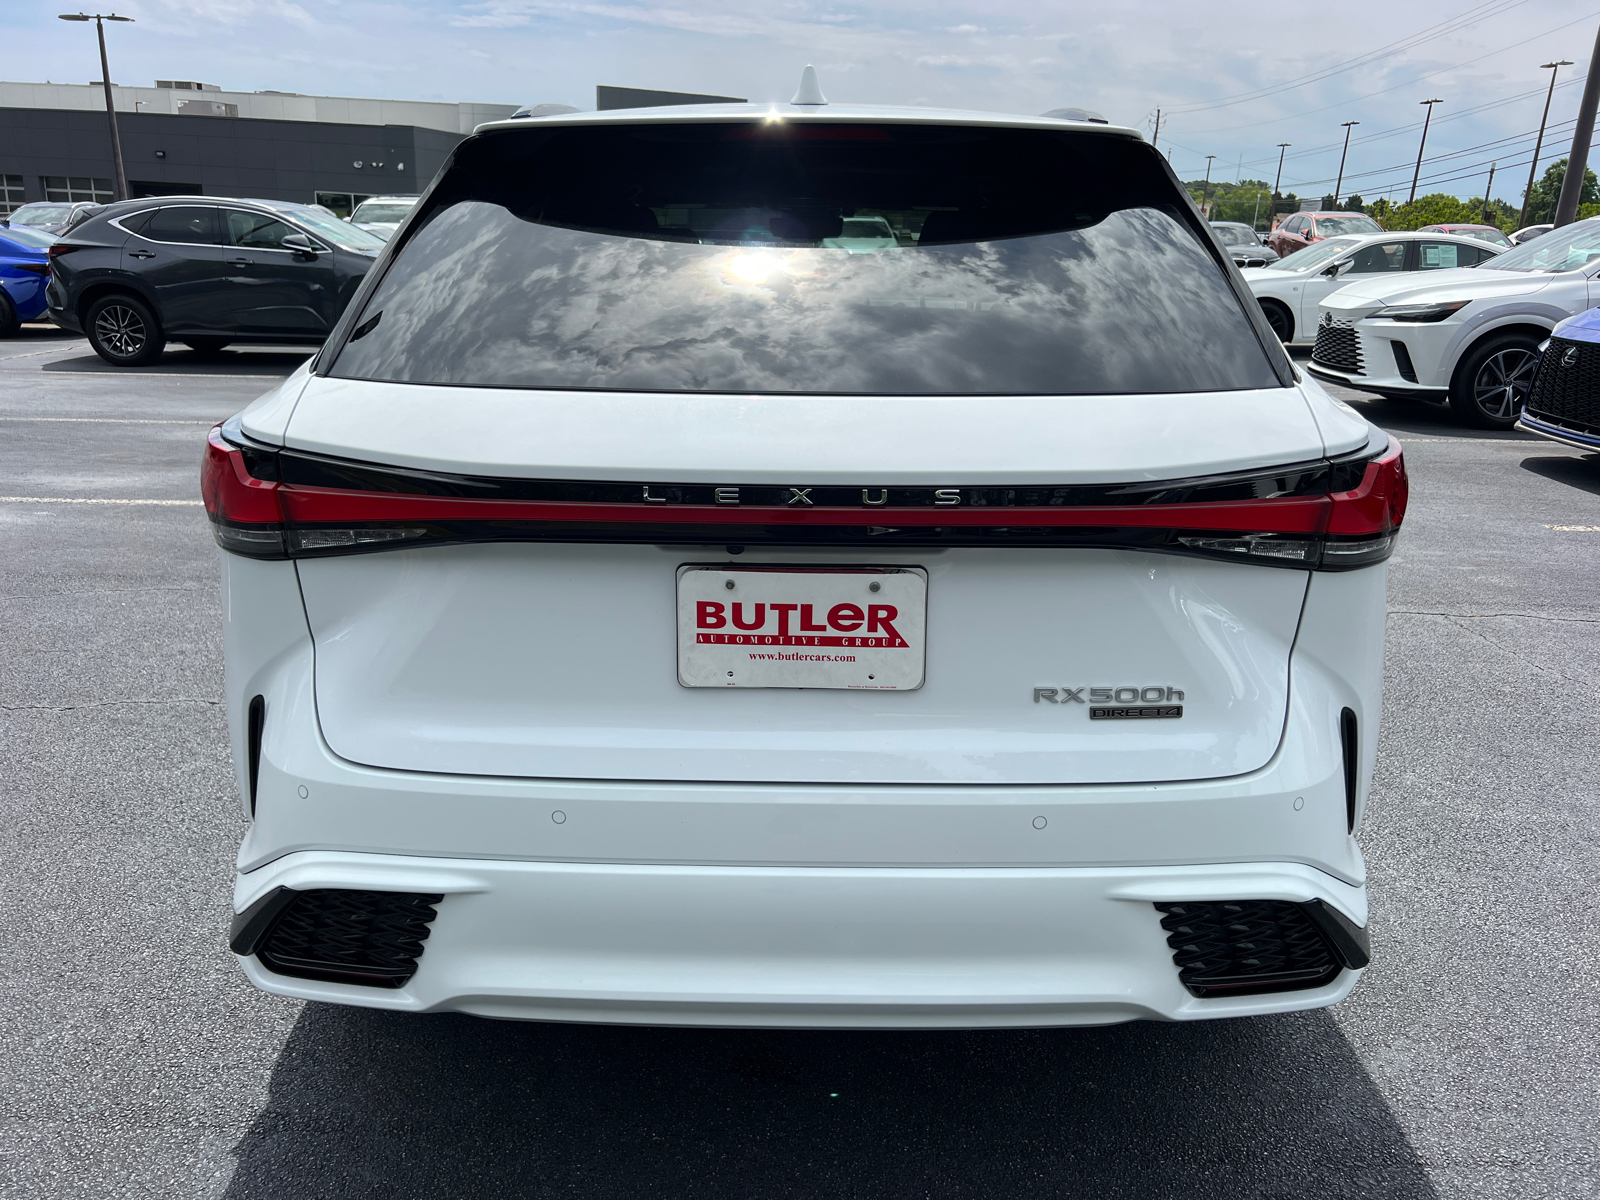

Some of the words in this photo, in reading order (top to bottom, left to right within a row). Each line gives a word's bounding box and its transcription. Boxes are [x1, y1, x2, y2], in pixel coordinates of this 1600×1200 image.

[642, 485, 961, 506] LEXUS
[697, 633, 821, 646] AUTOMOTIVE
[842, 636, 902, 648] GROUP
[749, 651, 856, 663] www.butlercars.com
